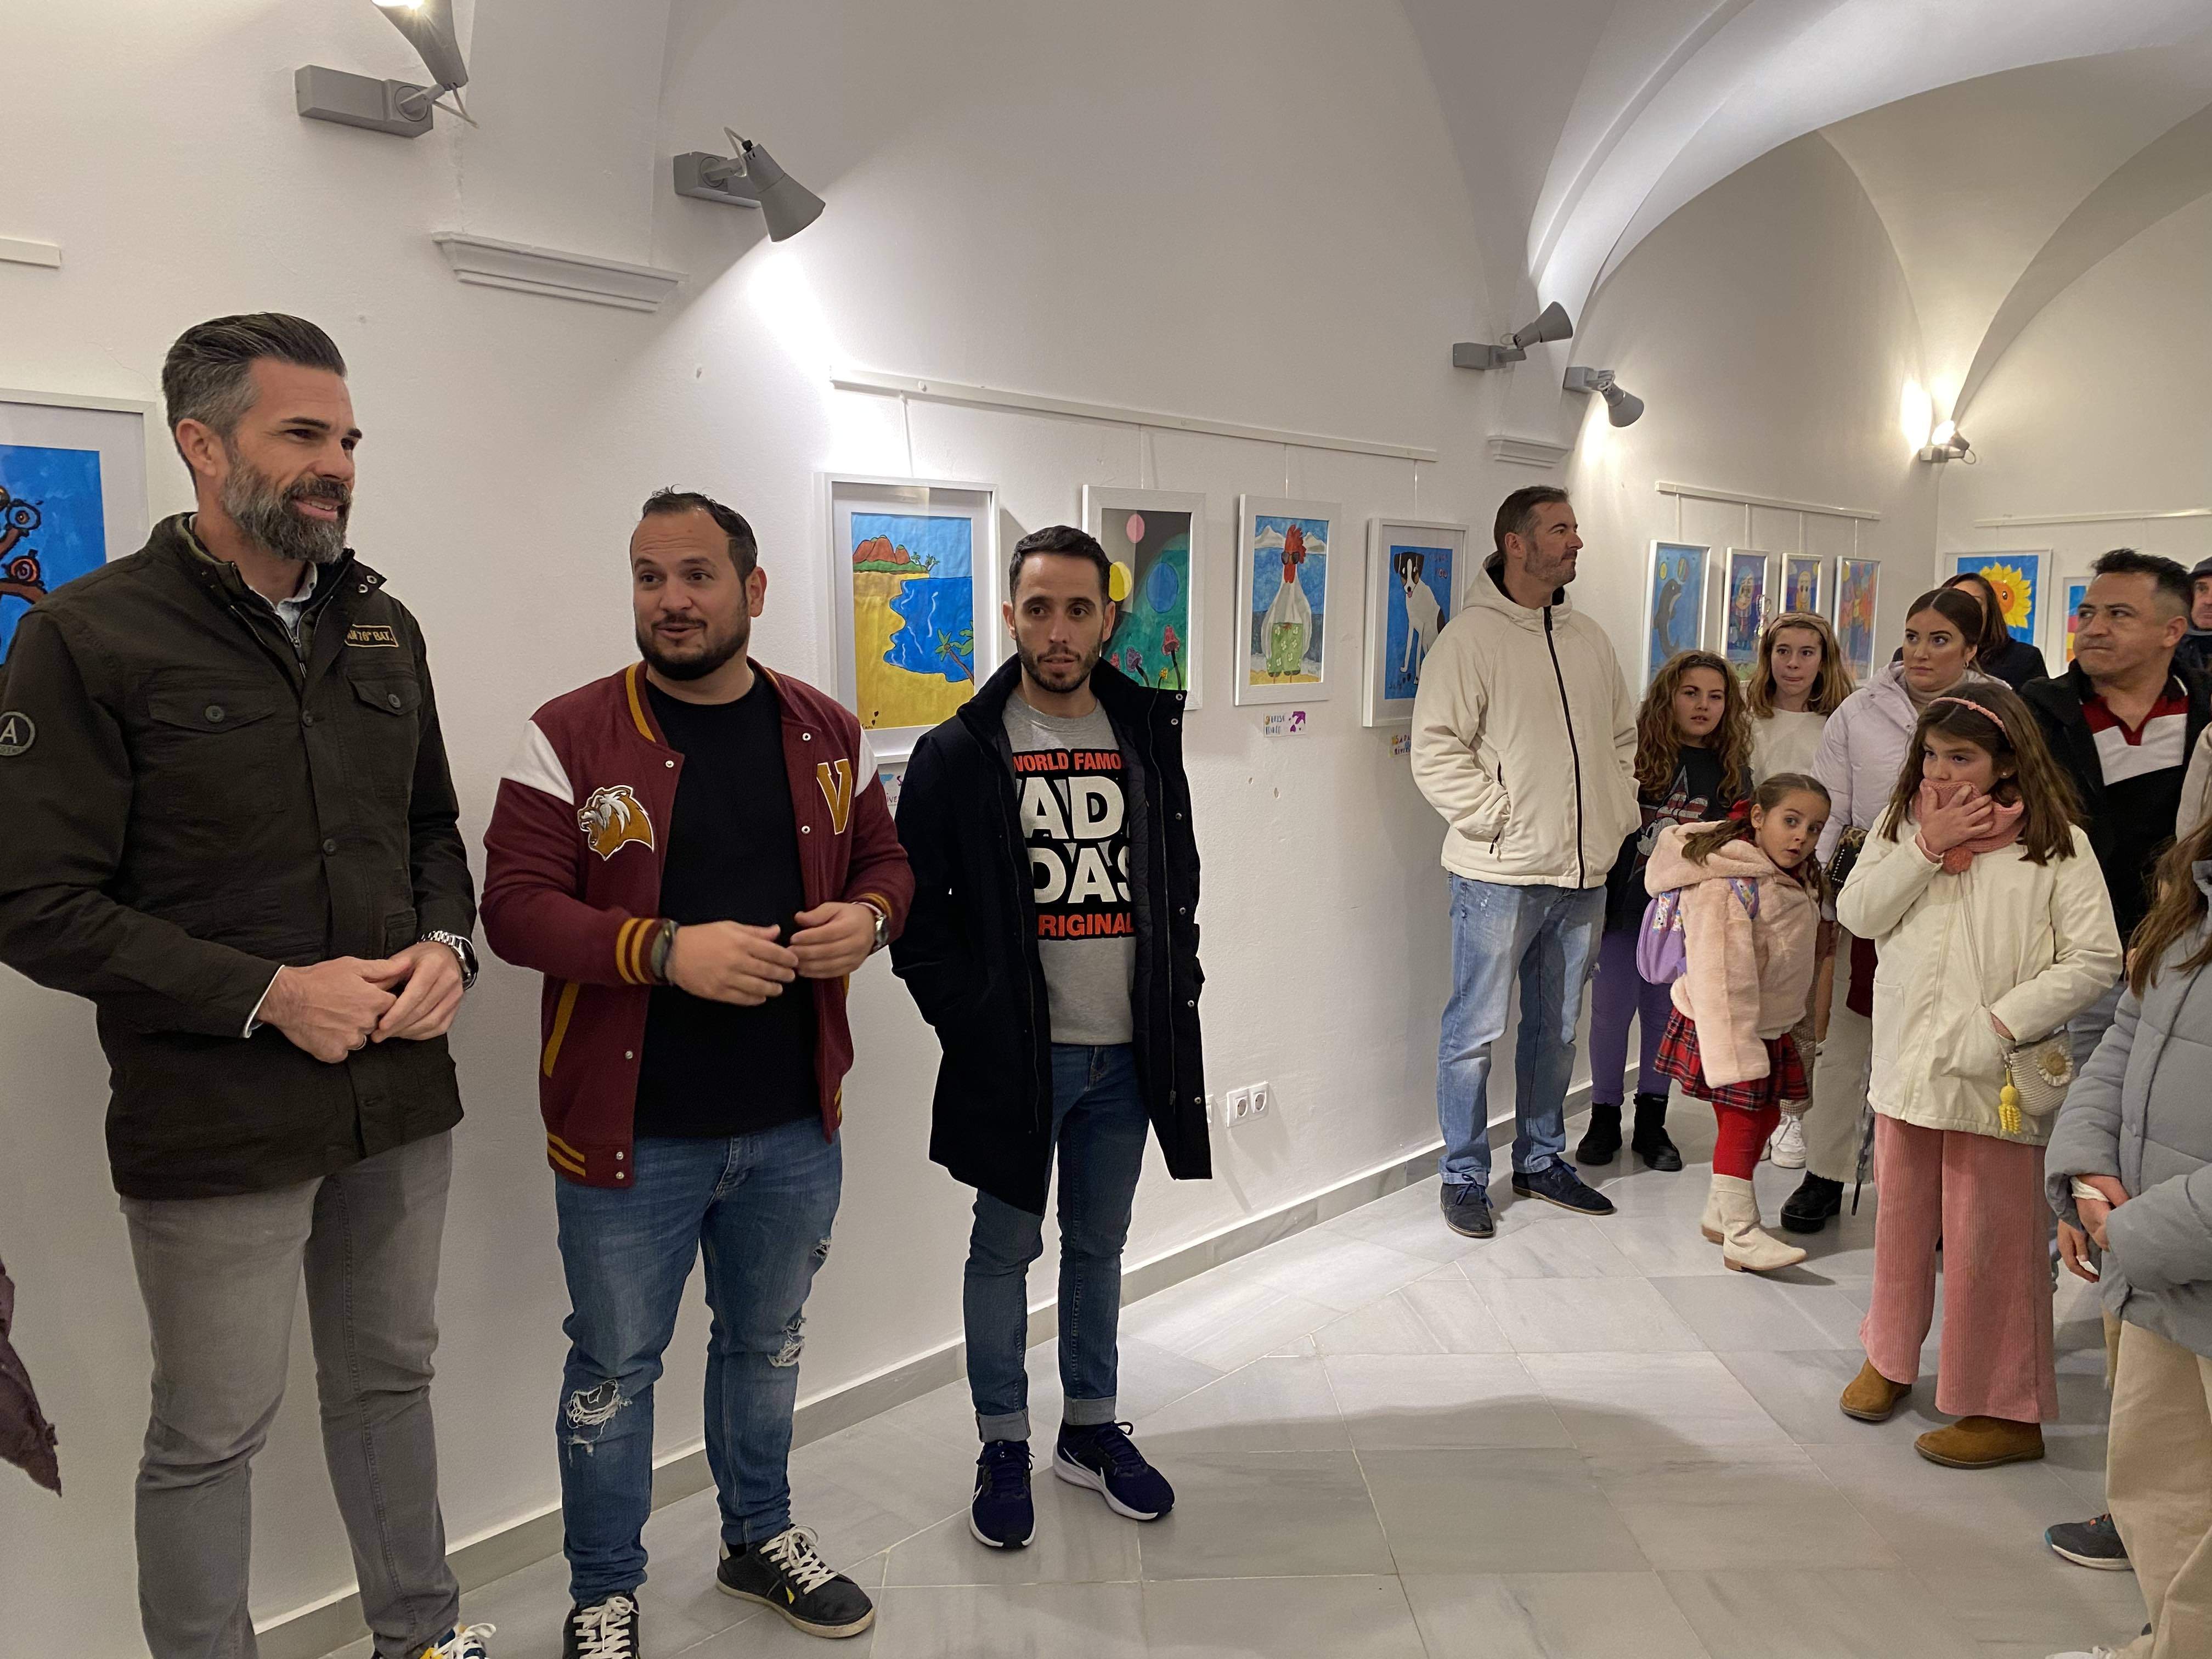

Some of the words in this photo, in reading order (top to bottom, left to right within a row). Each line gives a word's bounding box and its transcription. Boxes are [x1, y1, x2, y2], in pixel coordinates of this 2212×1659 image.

[1074, 752, 1121, 770] FAMO
[816, 758, 853, 835] V
[1020, 775, 1125, 839] AD
[1038, 912, 1134, 937] RIGINAL
